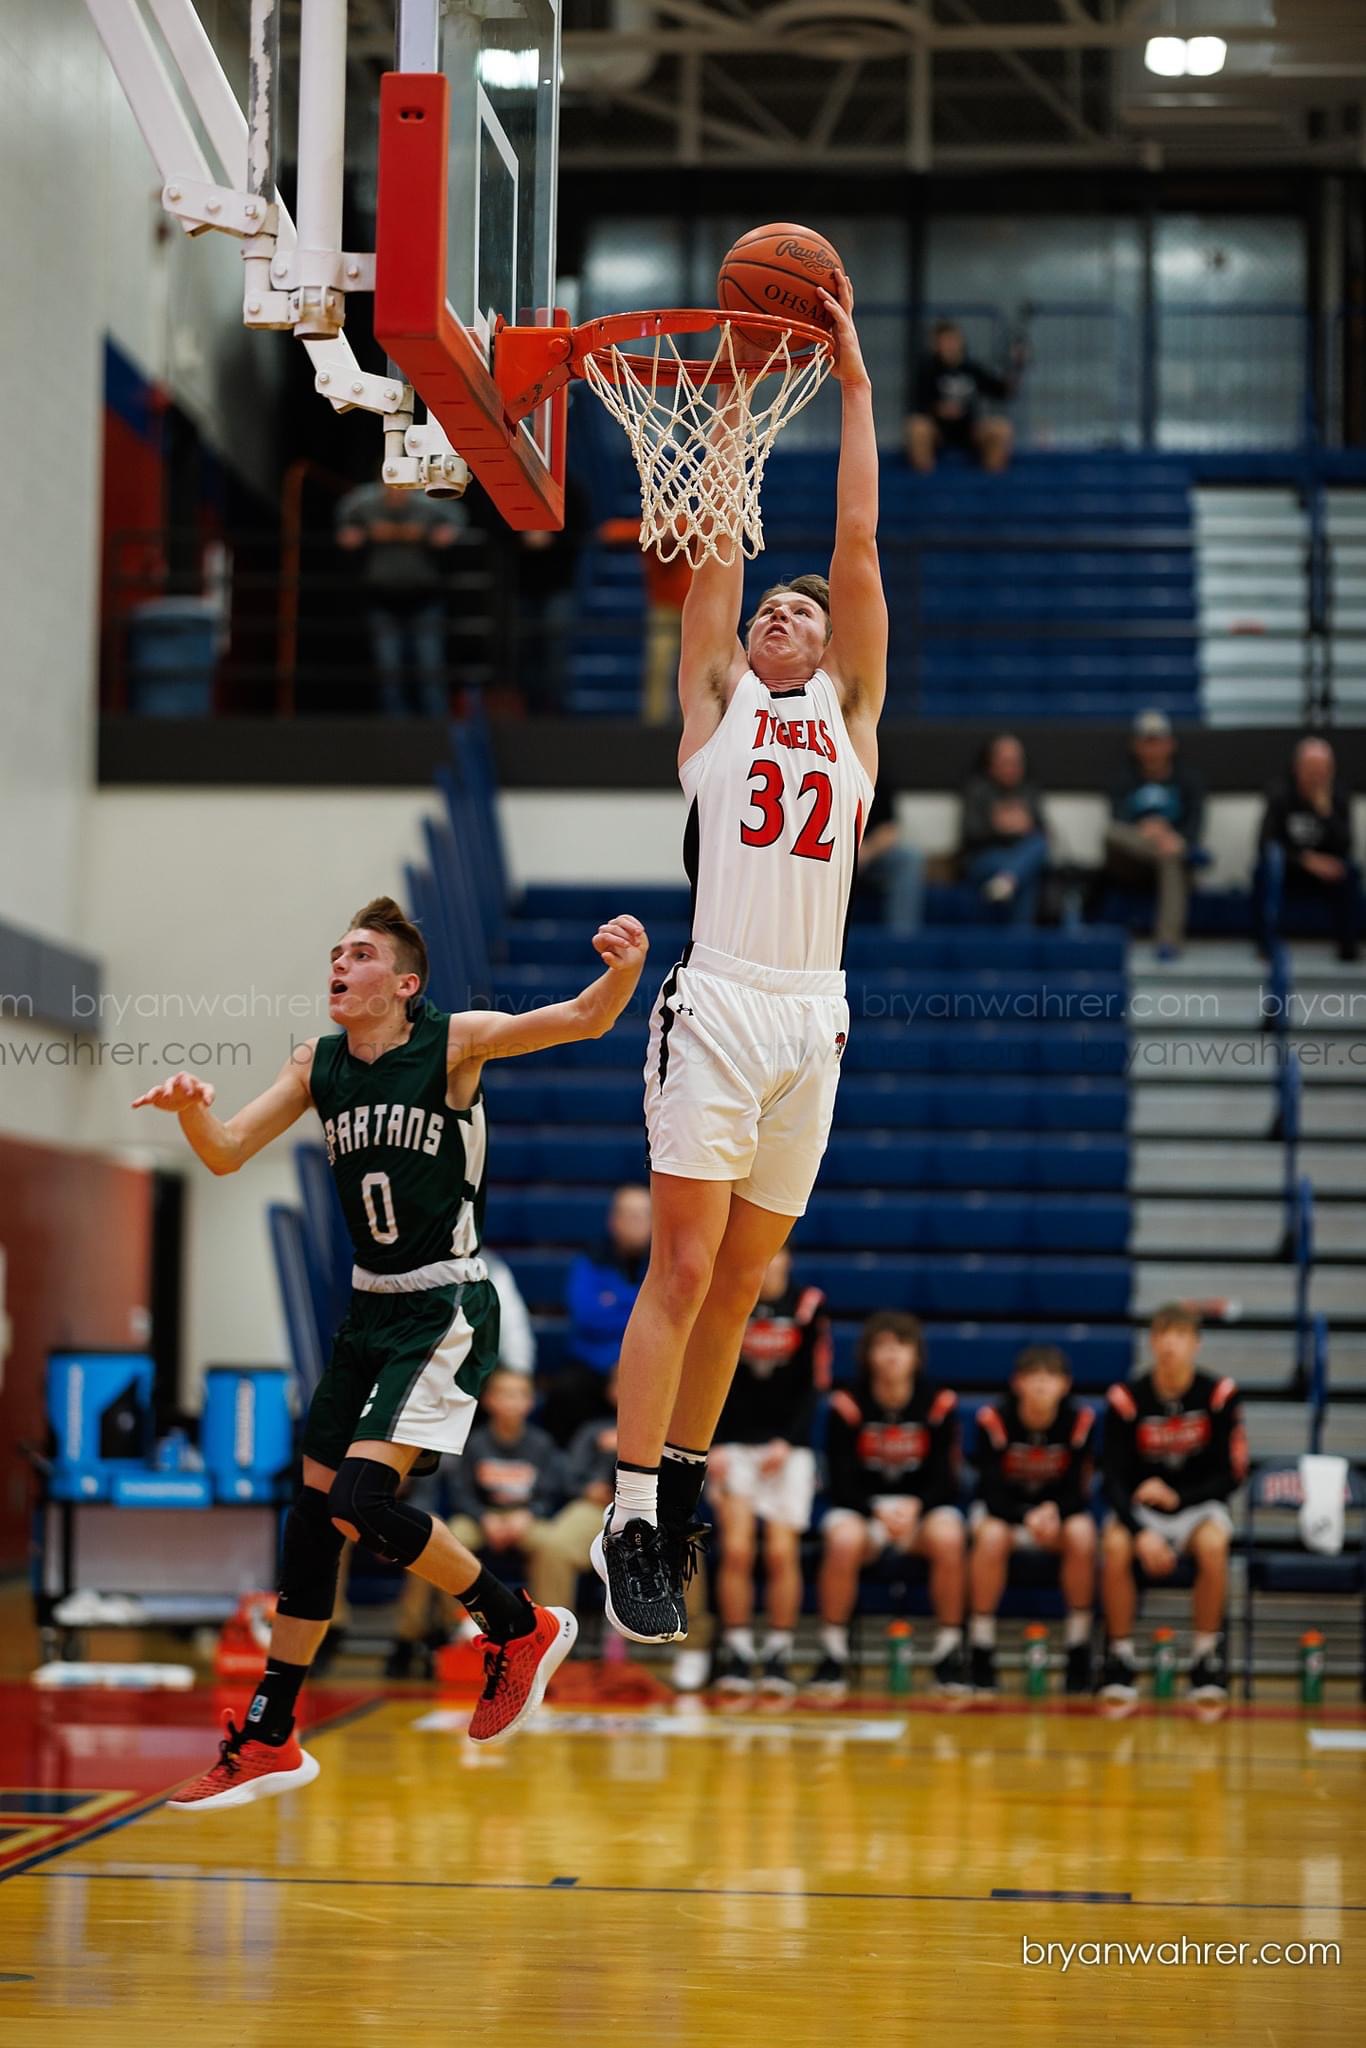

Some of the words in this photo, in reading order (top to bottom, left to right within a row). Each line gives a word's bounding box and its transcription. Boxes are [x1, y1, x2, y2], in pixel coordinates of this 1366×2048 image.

[752, 709, 837, 763] TIGERS
[740, 759, 836, 863] 32
[324, 1104, 444, 1166] PARTANS
[361, 1171, 399, 1245] 0
